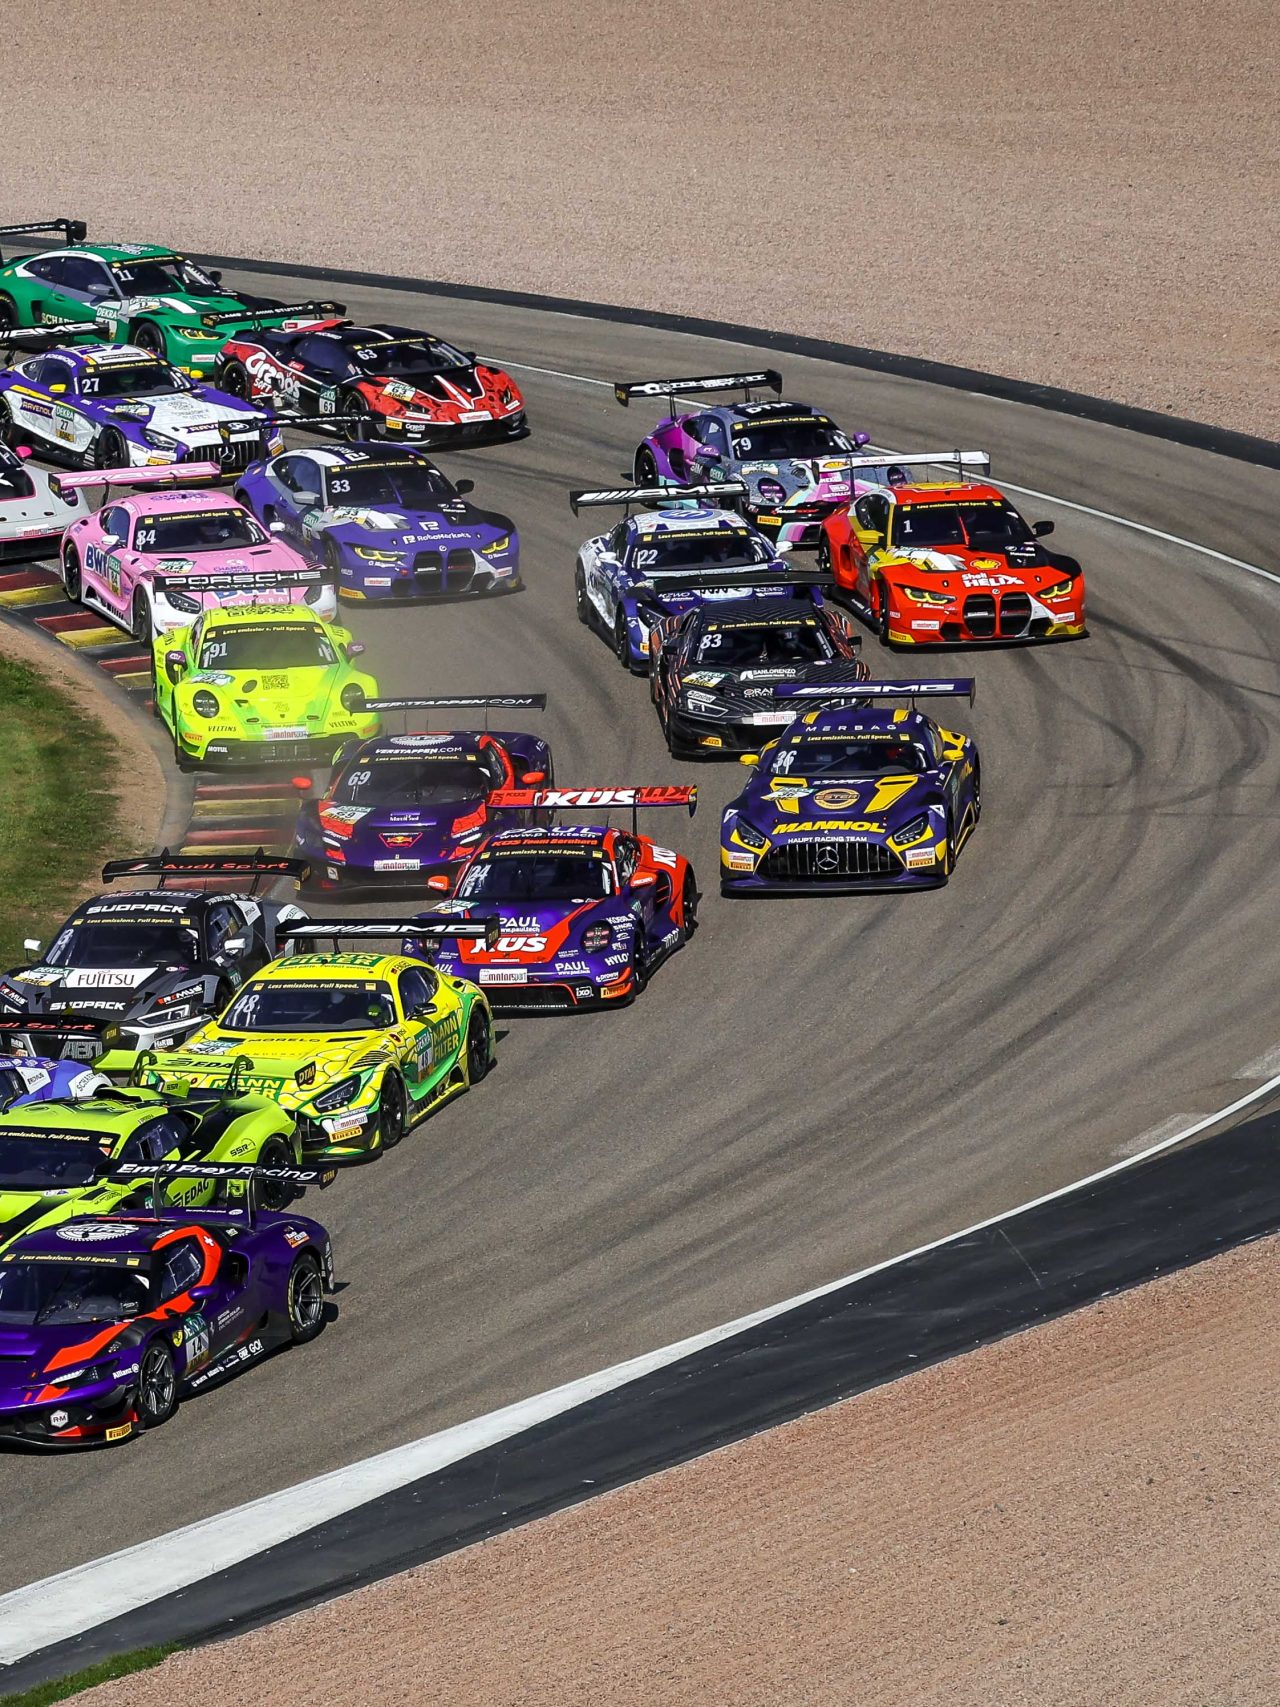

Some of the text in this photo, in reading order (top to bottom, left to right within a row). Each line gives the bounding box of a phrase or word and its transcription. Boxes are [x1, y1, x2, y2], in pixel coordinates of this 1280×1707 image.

[116, 270, 135, 281] 11
[97, 308, 118, 318] DEKRA
[356, 349, 378, 360] 63
[82, 378, 99, 393] 27
[22, 401, 53, 416] RAVENOL
[56, 406, 75, 419] DEKRA
[60, 420, 69, 431] 27
[331, 480, 351, 493] 33
[903, 520, 913, 533] 1
[137, 530, 156, 544] 84
[417, 533, 471, 542] RoboMarkets
[166, 572, 320, 585] PORSCHE
[961, 572, 988, 580] Shell
[962, 576, 1022, 588] HELIX
[700, 634, 722, 648] 83
[210, 643, 227, 657] 91
[329, 720, 357, 729] VELTINS
[773, 751, 797, 768] 36
[348, 771, 371, 785] 69
[772, 821, 886, 835] MANNOL
[499, 917, 541, 927] PAUL
[555, 961, 590, 971] PAUL
[605, 954, 628, 966] HYLO
[78, 969, 135, 987] FUJITSU
[234, 995, 259, 1012] 48
[433, 1017, 457, 1043] MANN
[416, 1031, 432, 1052] DEKRA
[433, 1035, 459, 1060] FILTER
[421, 1053, 429, 1069] 48
[298, 1067, 315, 1084] DTM
[332, 1127, 361, 1140] PIRELLI
[229, 1144, 249, 1157] SSR
[174, 1164, 231, 1176] Frey
[182, 1179, 209, 1206] EDAG
[192, 1336, 204, 1356] 14
[249, 1339, 262, 1354] GO!
[113, 1367, 132, 1379] Allianz
